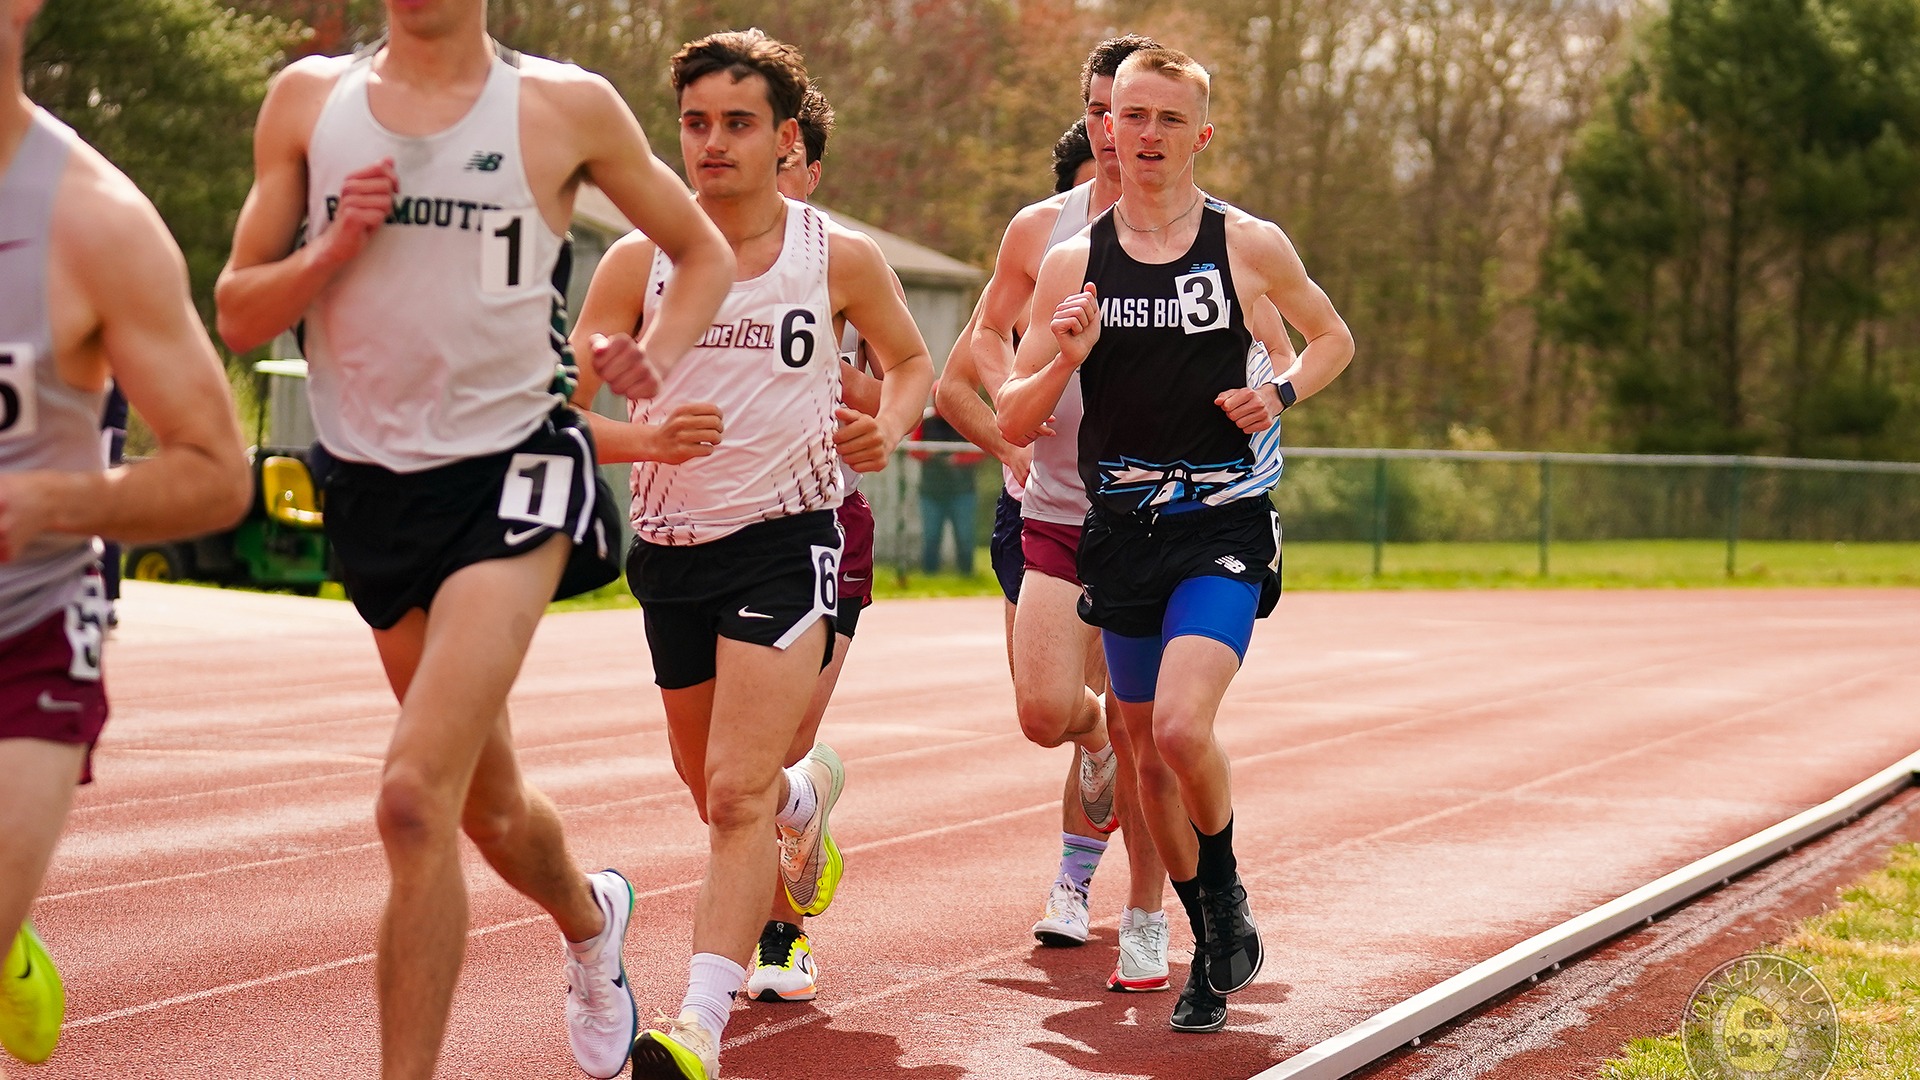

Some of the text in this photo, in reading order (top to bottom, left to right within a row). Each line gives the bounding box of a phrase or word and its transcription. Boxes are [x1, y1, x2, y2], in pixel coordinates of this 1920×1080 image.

[326, 195, 502, 232] PMOUT
[494, 217, 522, 286] 1
[1183, 276, 1219, 328] 3
[781, 309, 816, 369] 6
[518, 460, 549, 516] 1
[818, 551, 836, 610] 6
